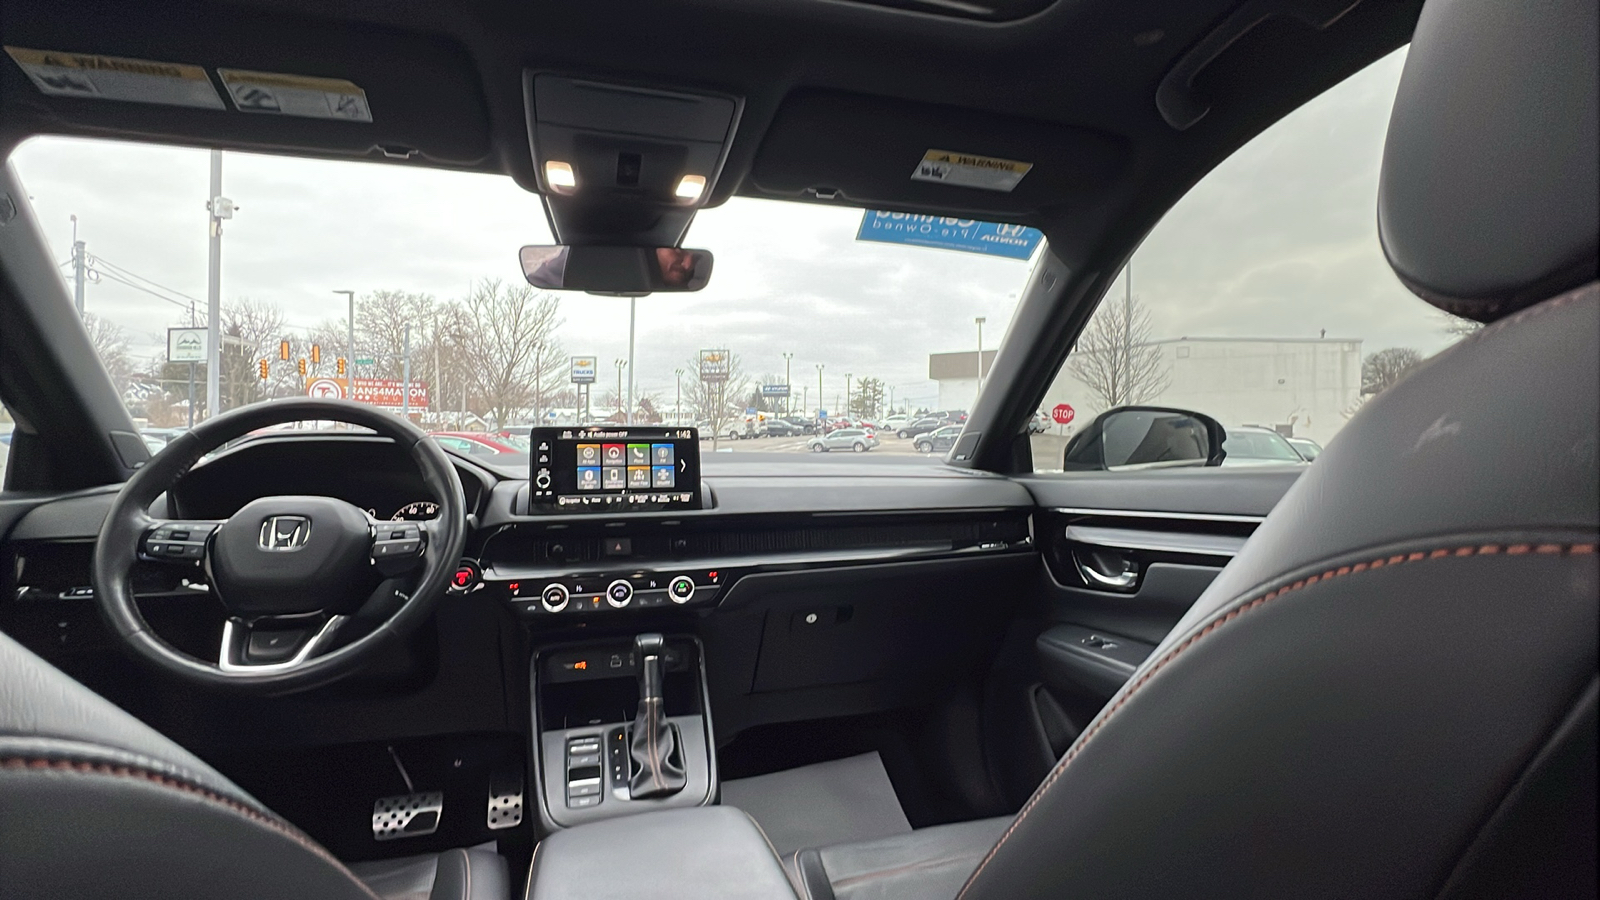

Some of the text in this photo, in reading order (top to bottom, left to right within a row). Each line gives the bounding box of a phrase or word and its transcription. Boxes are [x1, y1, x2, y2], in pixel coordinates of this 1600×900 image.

[957, 155, 1016, 171] WARNING
[344, 386, 426, 397] TRANS4MATON
[1053, 408, 1074, 419] STOP
[409, 507, 418, 515] 60
[426, 506, 435, 514] 80
